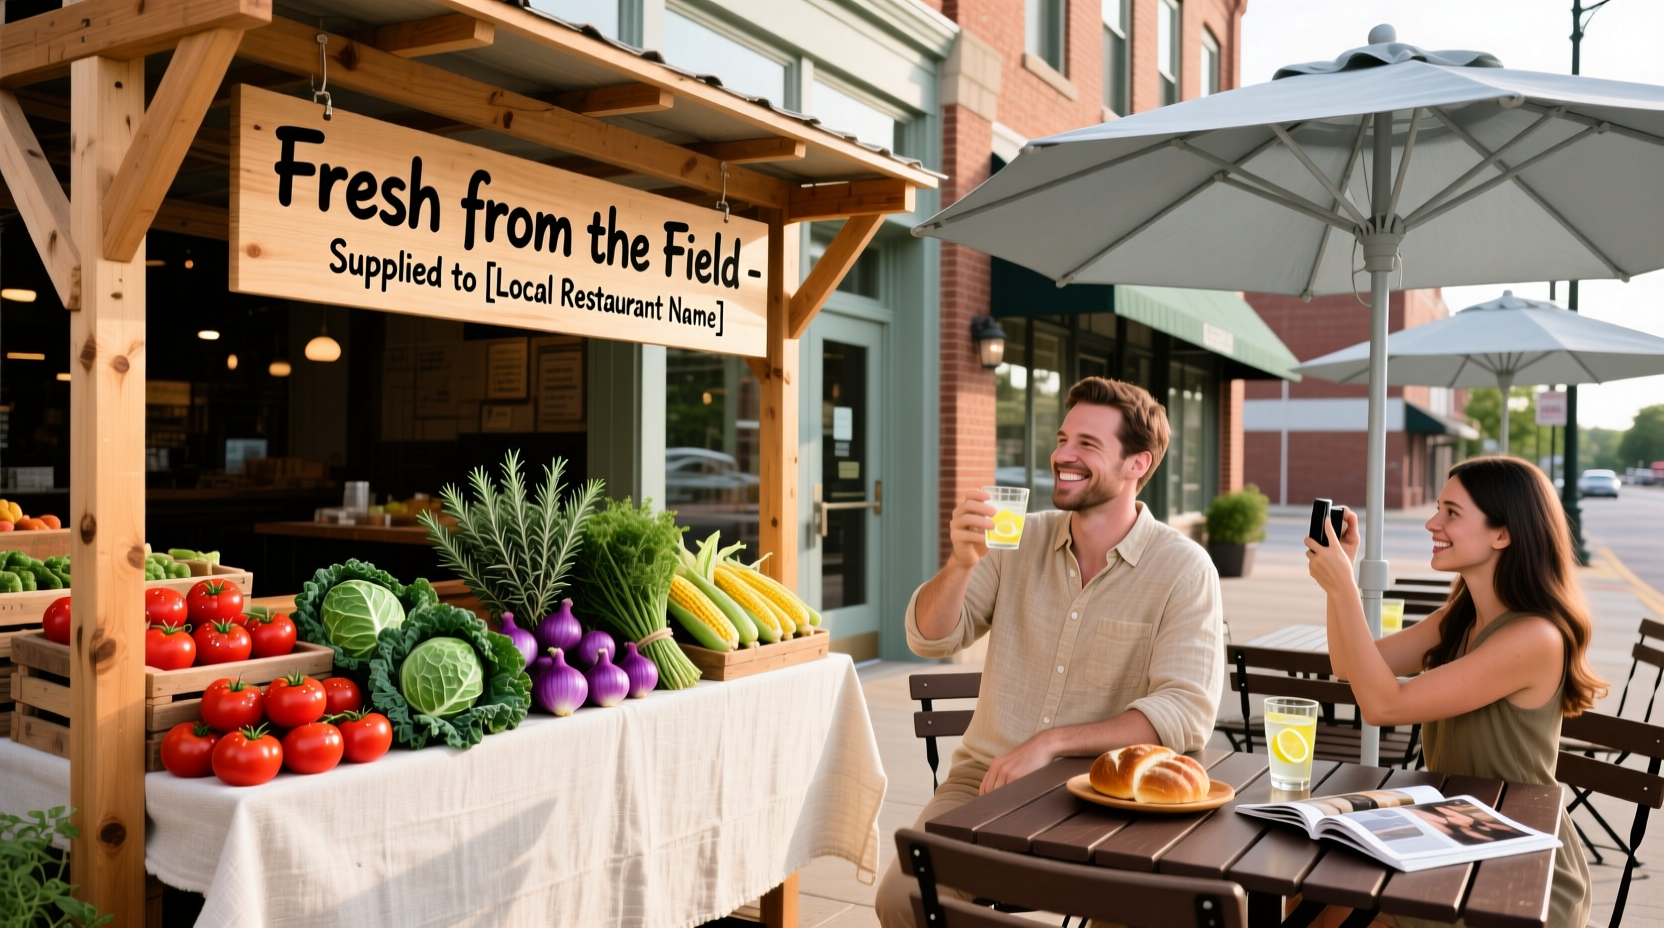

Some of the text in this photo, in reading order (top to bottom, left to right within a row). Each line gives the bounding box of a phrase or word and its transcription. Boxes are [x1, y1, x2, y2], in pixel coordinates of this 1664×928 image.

[274, 125, 441, 233] Fresh
[460, 168, 572, 258] from
[586, 205, 650, 273] the
[663, 220, 741, 290] Field
[329, 237, 724, 337] Supplied to [Local Restaurant Name]
